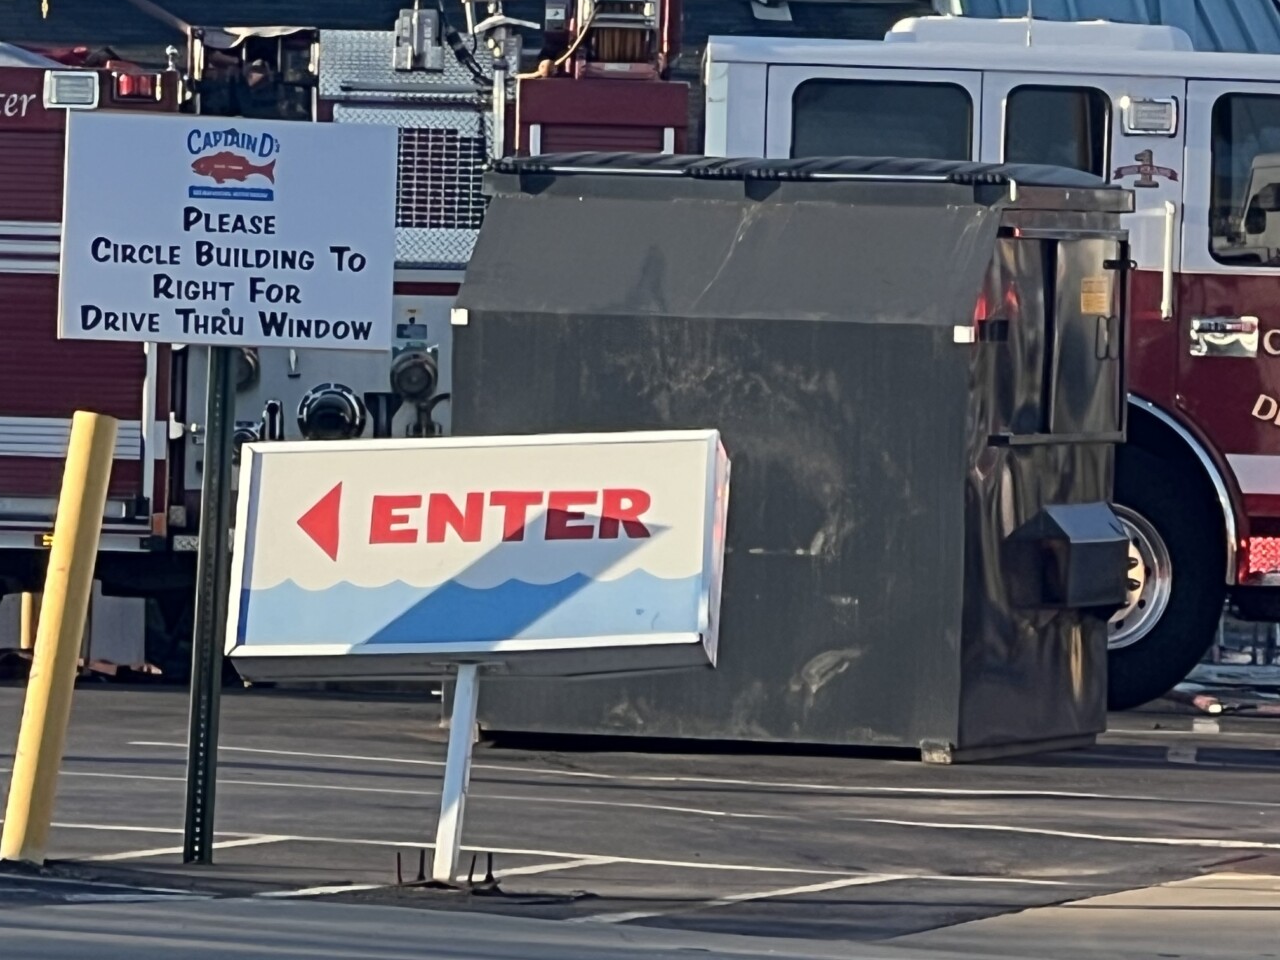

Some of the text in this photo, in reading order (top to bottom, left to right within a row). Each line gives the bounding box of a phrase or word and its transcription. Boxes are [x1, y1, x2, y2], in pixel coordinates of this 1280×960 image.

[187, 127, 258, 155] CAPTAIN
[183, 206, 276, 235] PLEASE
[91, 236, 367, 272] CIRCLE BUILDING TO
[153, 273, 302, 305] RIGHT FOR
[80, 304, 373, 341] DRIVE THRU WINDOW
[369, 488, 652, 544] ENTER
